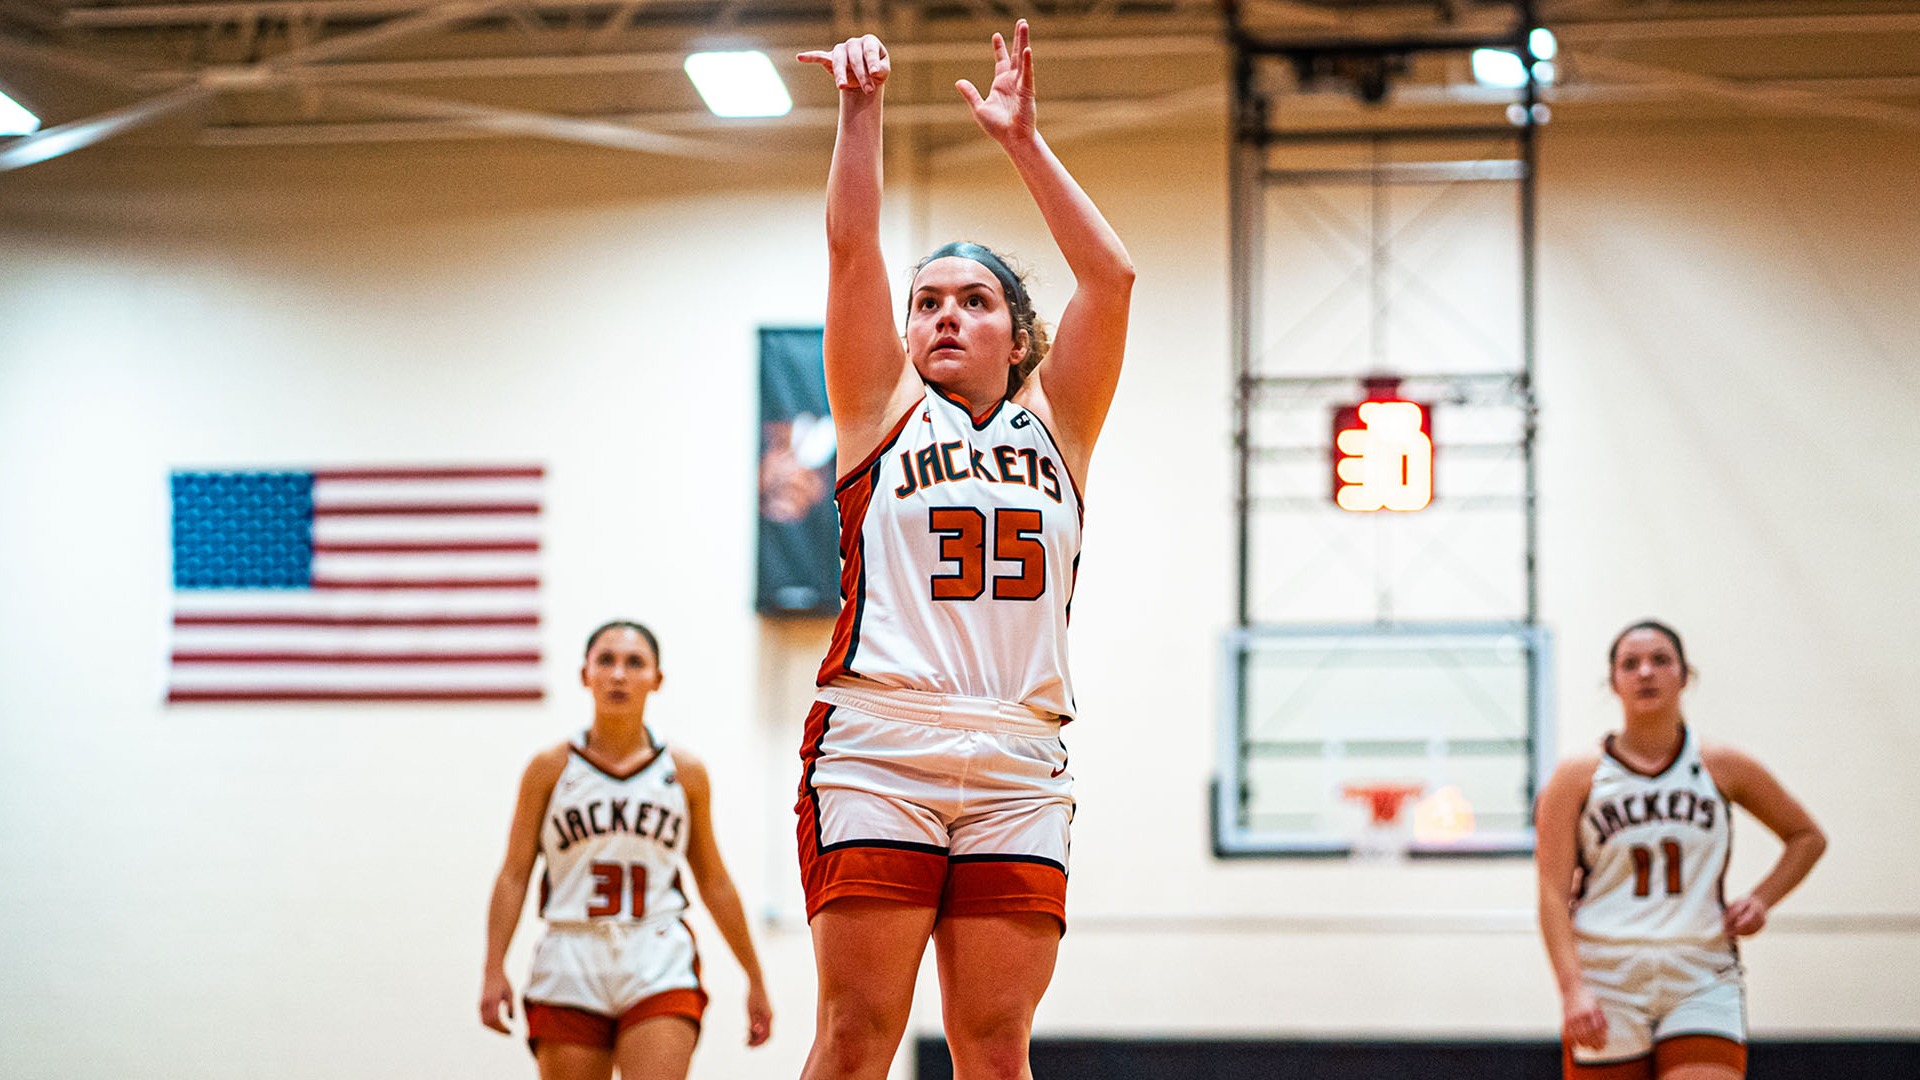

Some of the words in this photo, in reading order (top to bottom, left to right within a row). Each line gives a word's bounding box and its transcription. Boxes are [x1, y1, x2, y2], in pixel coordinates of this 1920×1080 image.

[894, 439, 1062, 504] JACKETS
[929, 506, 1046, 601] 35
[552, 798, 682, 849] JACKETS
[1589, 789, 1716, 845] JACKETS
[588, 861, 647, 919] 31
[1630, 836, 1682, 898] 11
